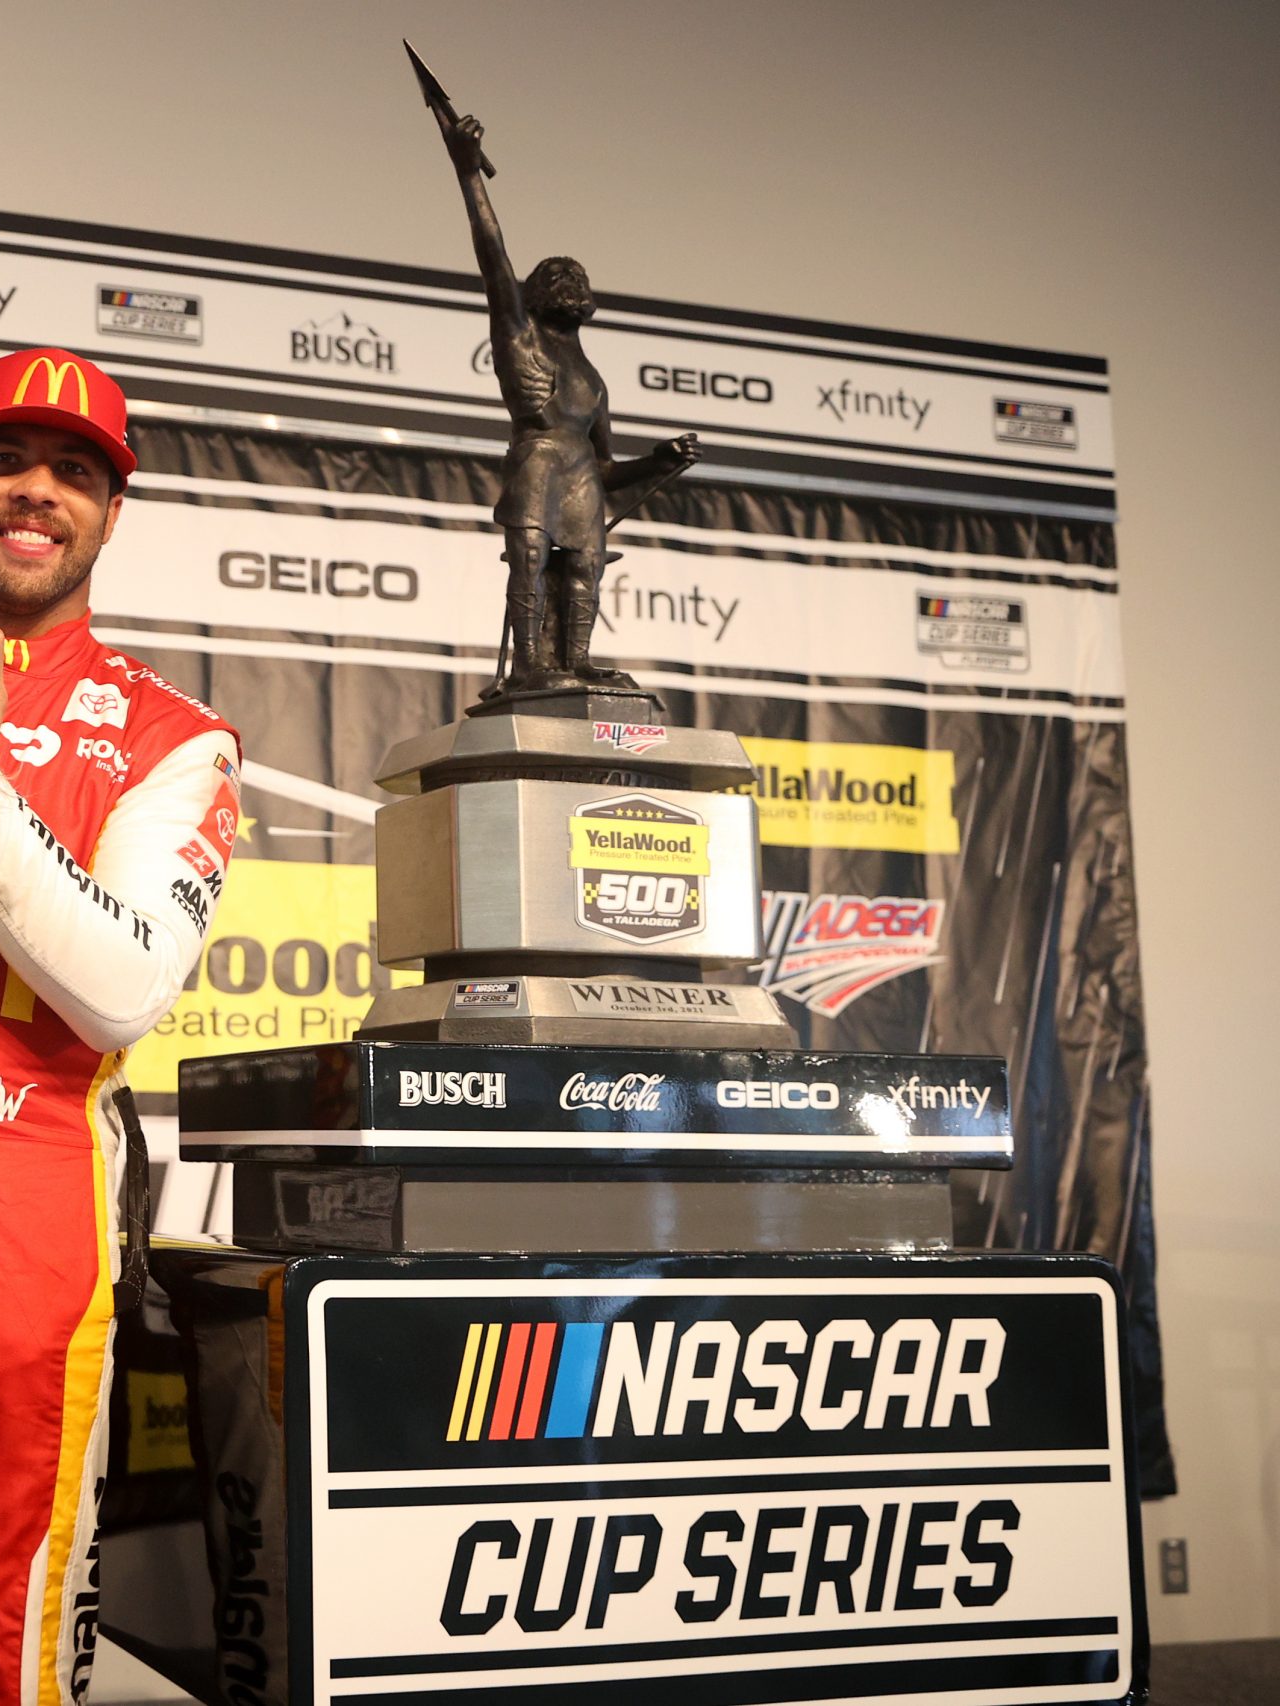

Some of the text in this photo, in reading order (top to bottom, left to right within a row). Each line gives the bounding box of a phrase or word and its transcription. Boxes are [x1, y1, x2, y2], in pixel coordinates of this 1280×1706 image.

[290, 331, 397, 372] BUSCH
[639, 364, 774, 403] GEICO
[818, 379, 932, 430] xfinity
[218, 550, 419, 601] GEICO
[590, 848, 631, 860] Pressure
[634, 851, 670, 862] Treated
[597, 873, 689, 917] 500
[132, 909, 153, 952] it
[614, 915, 681, 927] TALLADEGA
[477, 983, 510, 993] NASCAR
[570, 983, 733, 1006] WINNER
[153, 1005, 279, 1038] eated
[610, 1004, 653, 1013] October
[681, 1006, 704, 1014] 2021
[399, 1071, 506, 1108] BUSCH
[716, 1080, 839, 1110] GEICO
[887, 1077, 991, 1119] xfinity
[594, 1317, 1007, 1439] NASCAR
[438, 1498, 1022, 1637] CUP SERIES
